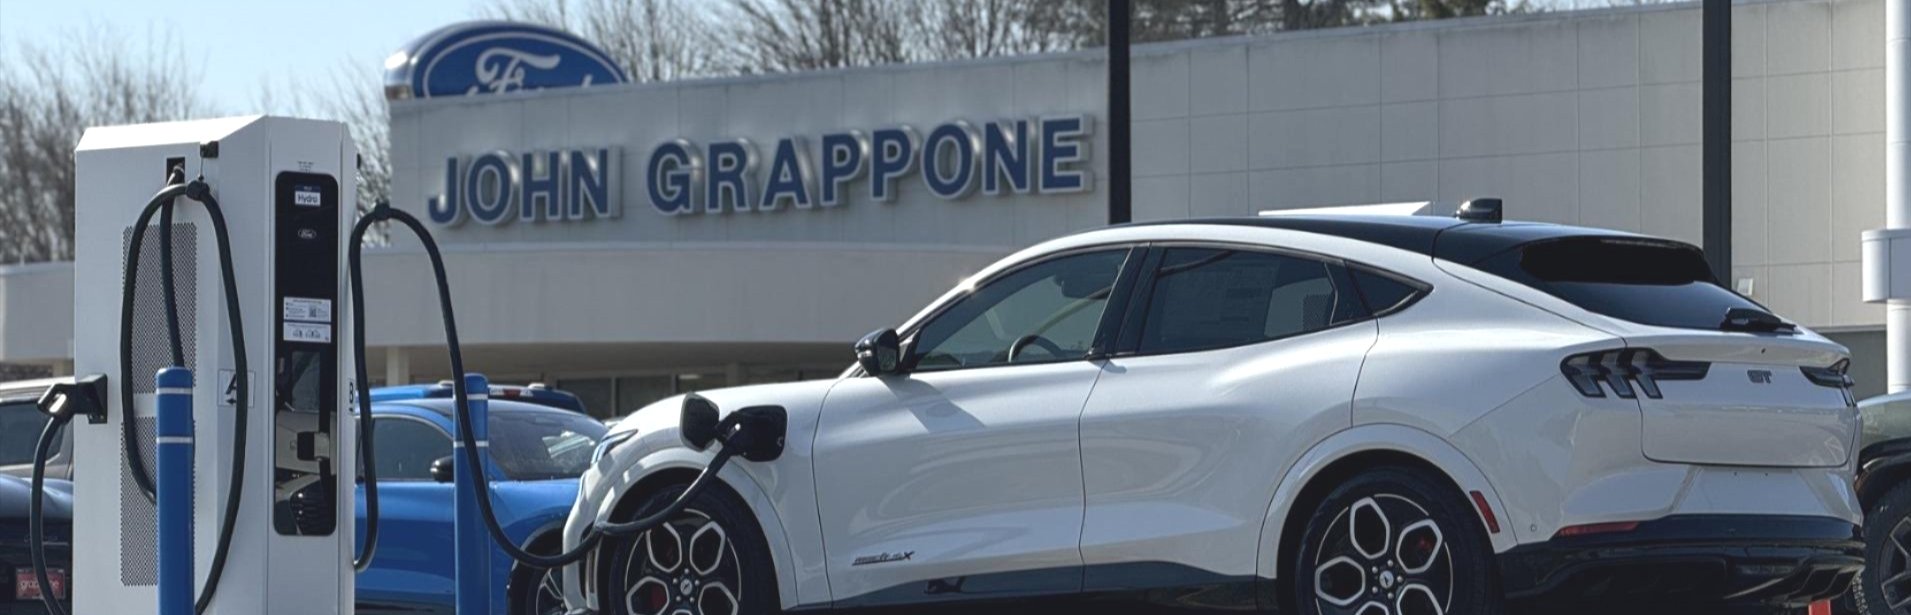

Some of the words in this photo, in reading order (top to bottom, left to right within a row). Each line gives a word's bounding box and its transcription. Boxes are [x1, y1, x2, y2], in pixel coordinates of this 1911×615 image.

[427, 148, 610, 225] JOHN
[646, 117, 1087, 214] GRAPPONE
[1746, 369, 1772, 384] GT
